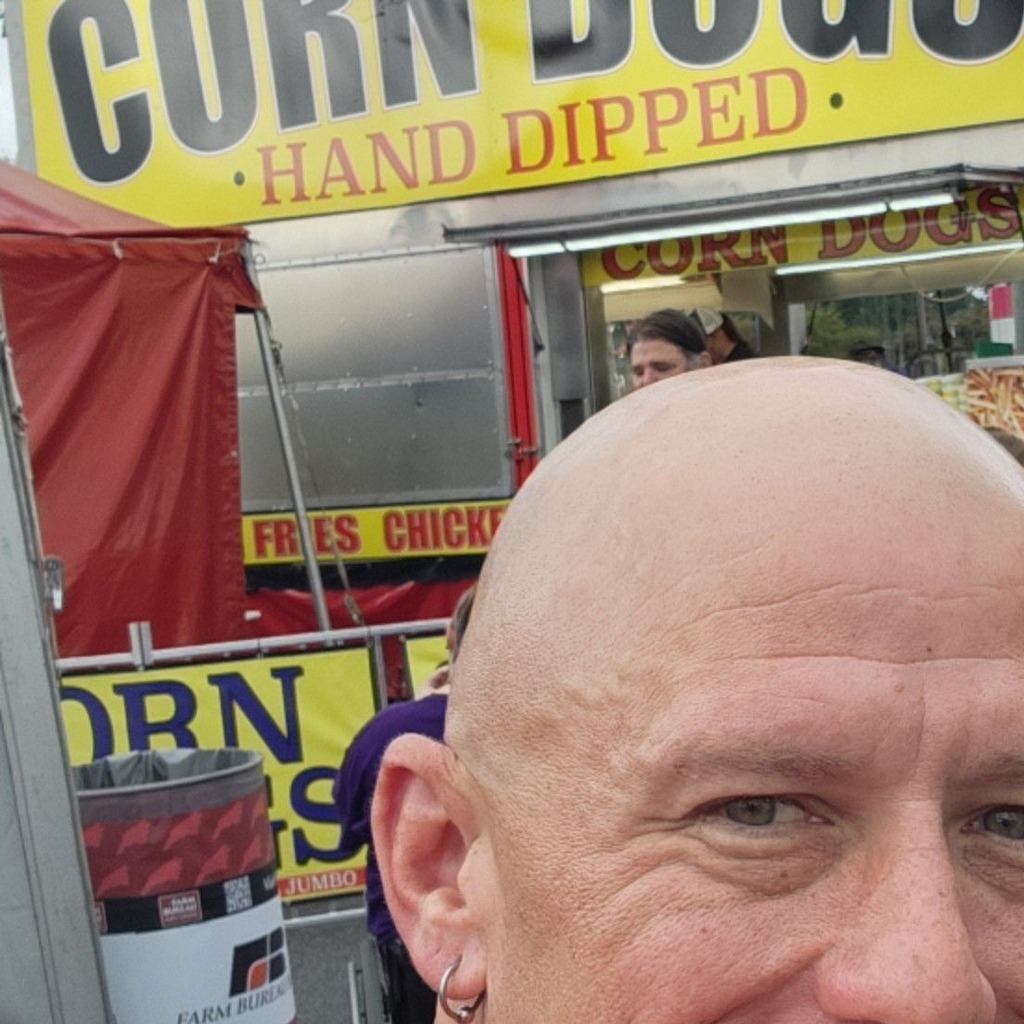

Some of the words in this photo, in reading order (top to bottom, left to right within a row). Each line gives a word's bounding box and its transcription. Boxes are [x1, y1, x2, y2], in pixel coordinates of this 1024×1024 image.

[257, 118, 477, 206] HAND
[501, 67, 809, 175] DIPPED
[601, 226, 789, 280] CORN
[818, 185, 1022, 259] DOGS
[253, 514, 362, 558] FRES
[284, 870, 357, 895] JUMBO
